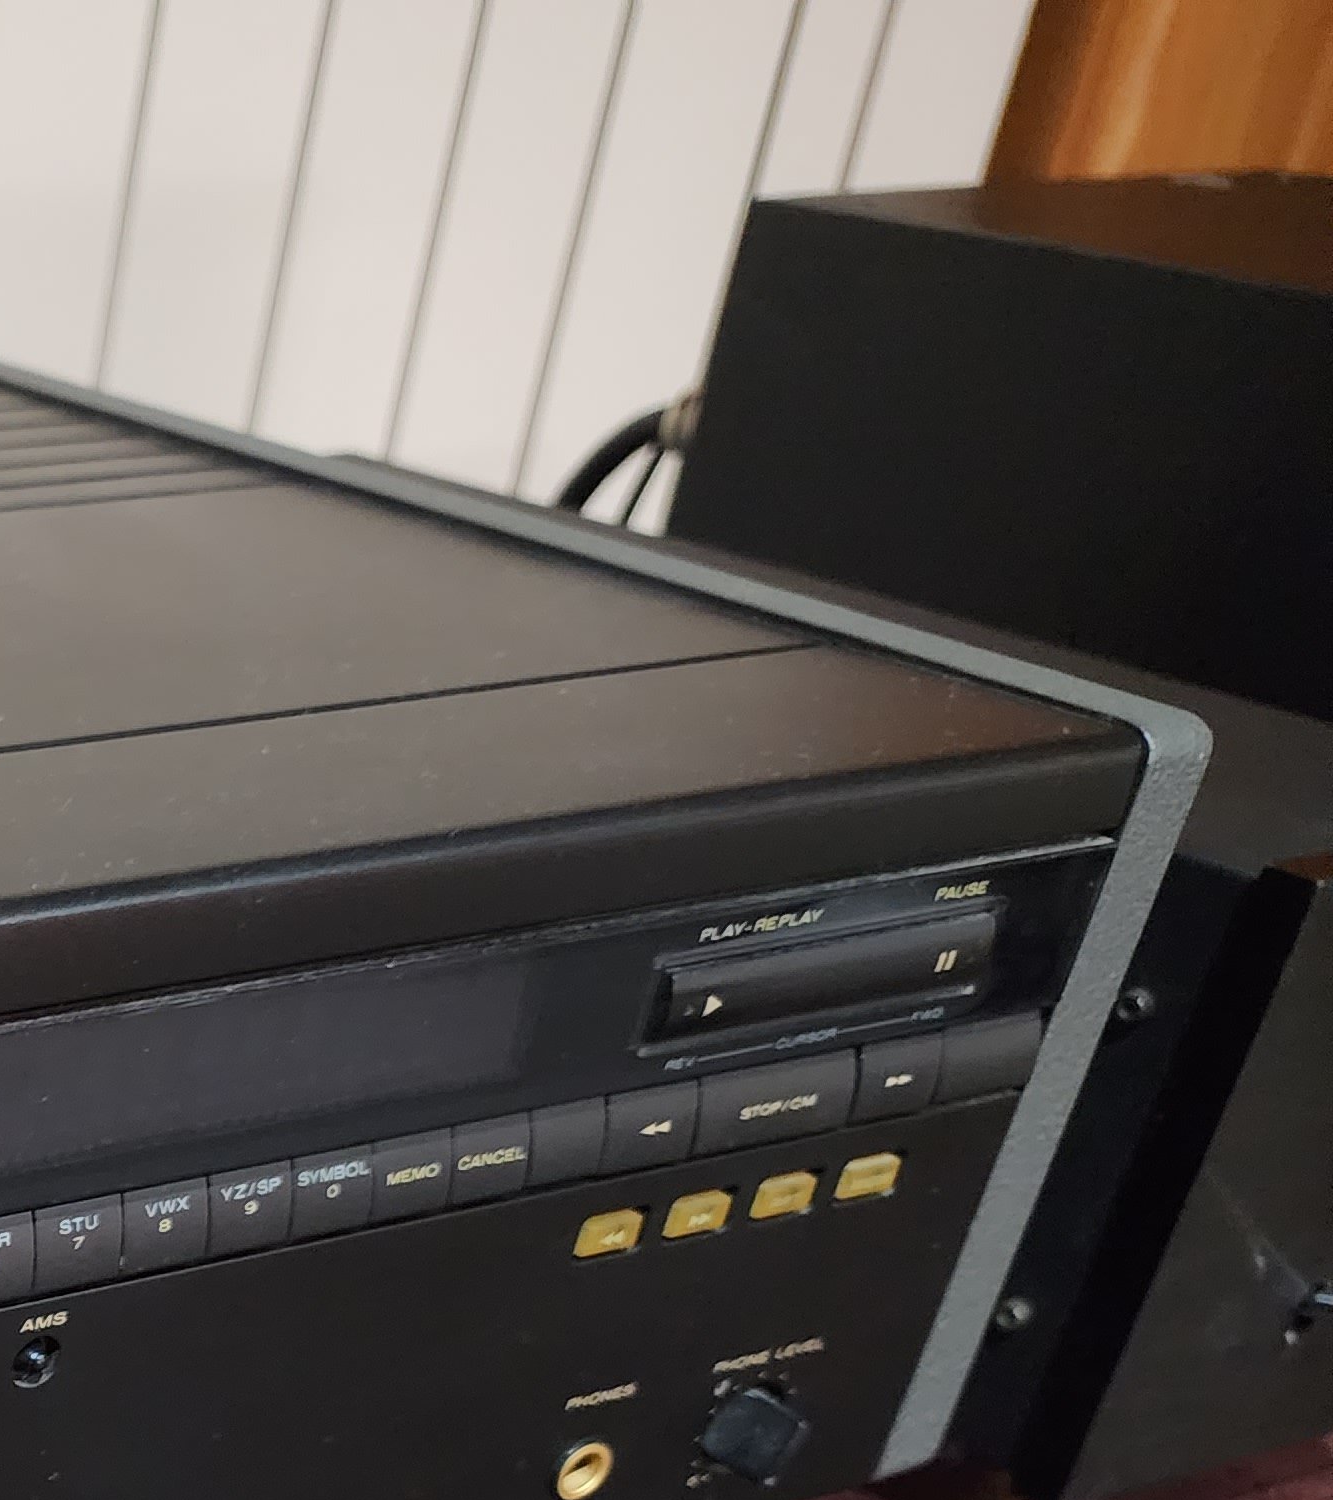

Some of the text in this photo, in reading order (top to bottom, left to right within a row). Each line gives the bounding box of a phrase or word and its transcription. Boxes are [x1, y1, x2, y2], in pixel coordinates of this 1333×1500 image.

[934, 880, 990, 901] PAUSE
[698, 908, 824, 943] PLAY-REPLAY
[457, 1146, 527, 1172] CANCEL
[297, 1160, 371, 1188] SYMBOL
[386, 1162, 443, 1188] MEMO
[220, 1176, 282, 1202] YZ/SP
[144, 1195, 190, 1218] VWX
[244, 1200, 258, 1216] 9
[58, 1213, 100, 1236] STU
[158, 1217, 173, 1233] 8
[72, 1235, 85, 1250] 7
[19, 1311, 69, 1333] AMS
